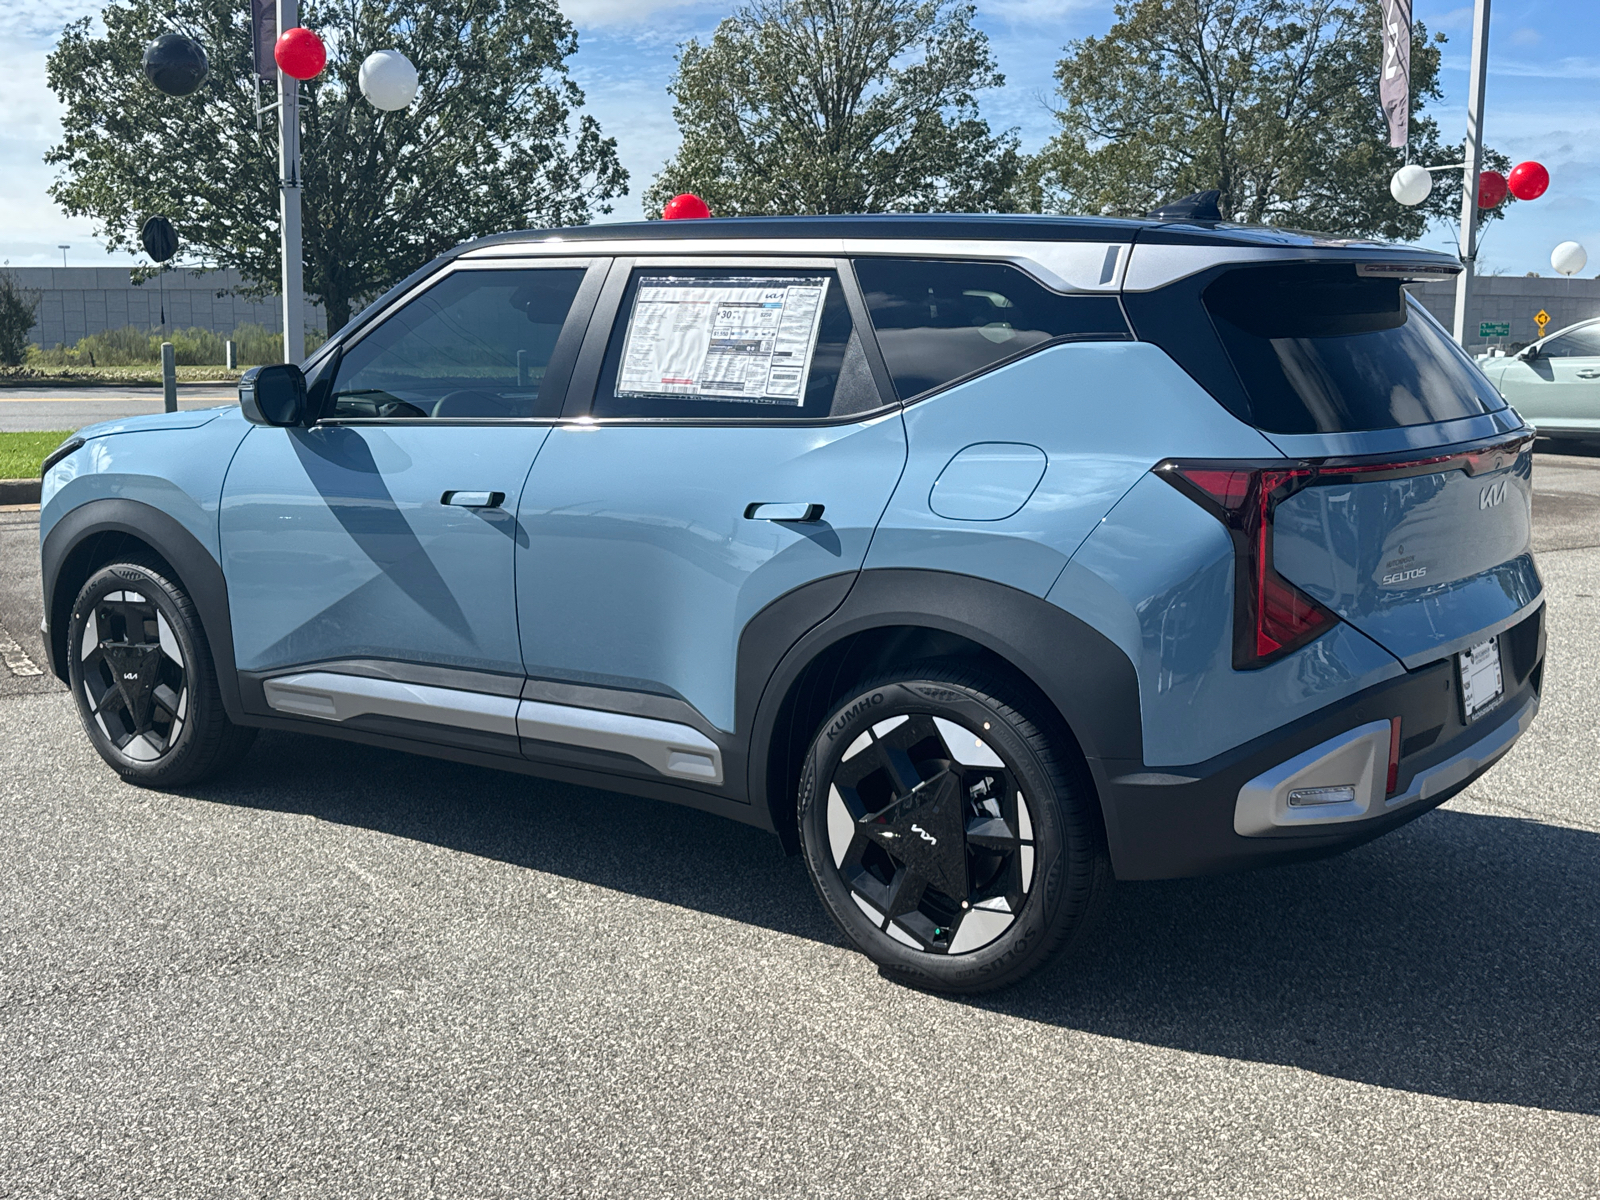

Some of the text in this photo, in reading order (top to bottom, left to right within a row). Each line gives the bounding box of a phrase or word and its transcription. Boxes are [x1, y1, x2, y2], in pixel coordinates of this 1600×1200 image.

[720, 310, 733, 320] 30
[1479, 480, 1507, 510] KIA
[1382, 566, 1427, 586] SELTOS
[123, 672, 138, 680] KIA
[826, 692, 884, 741] KUMHO
[158, 741, 189, 776] KUMHO
[910, 823, 937, 846] KIA
[978, 926, 1037, 977] SOLUS
